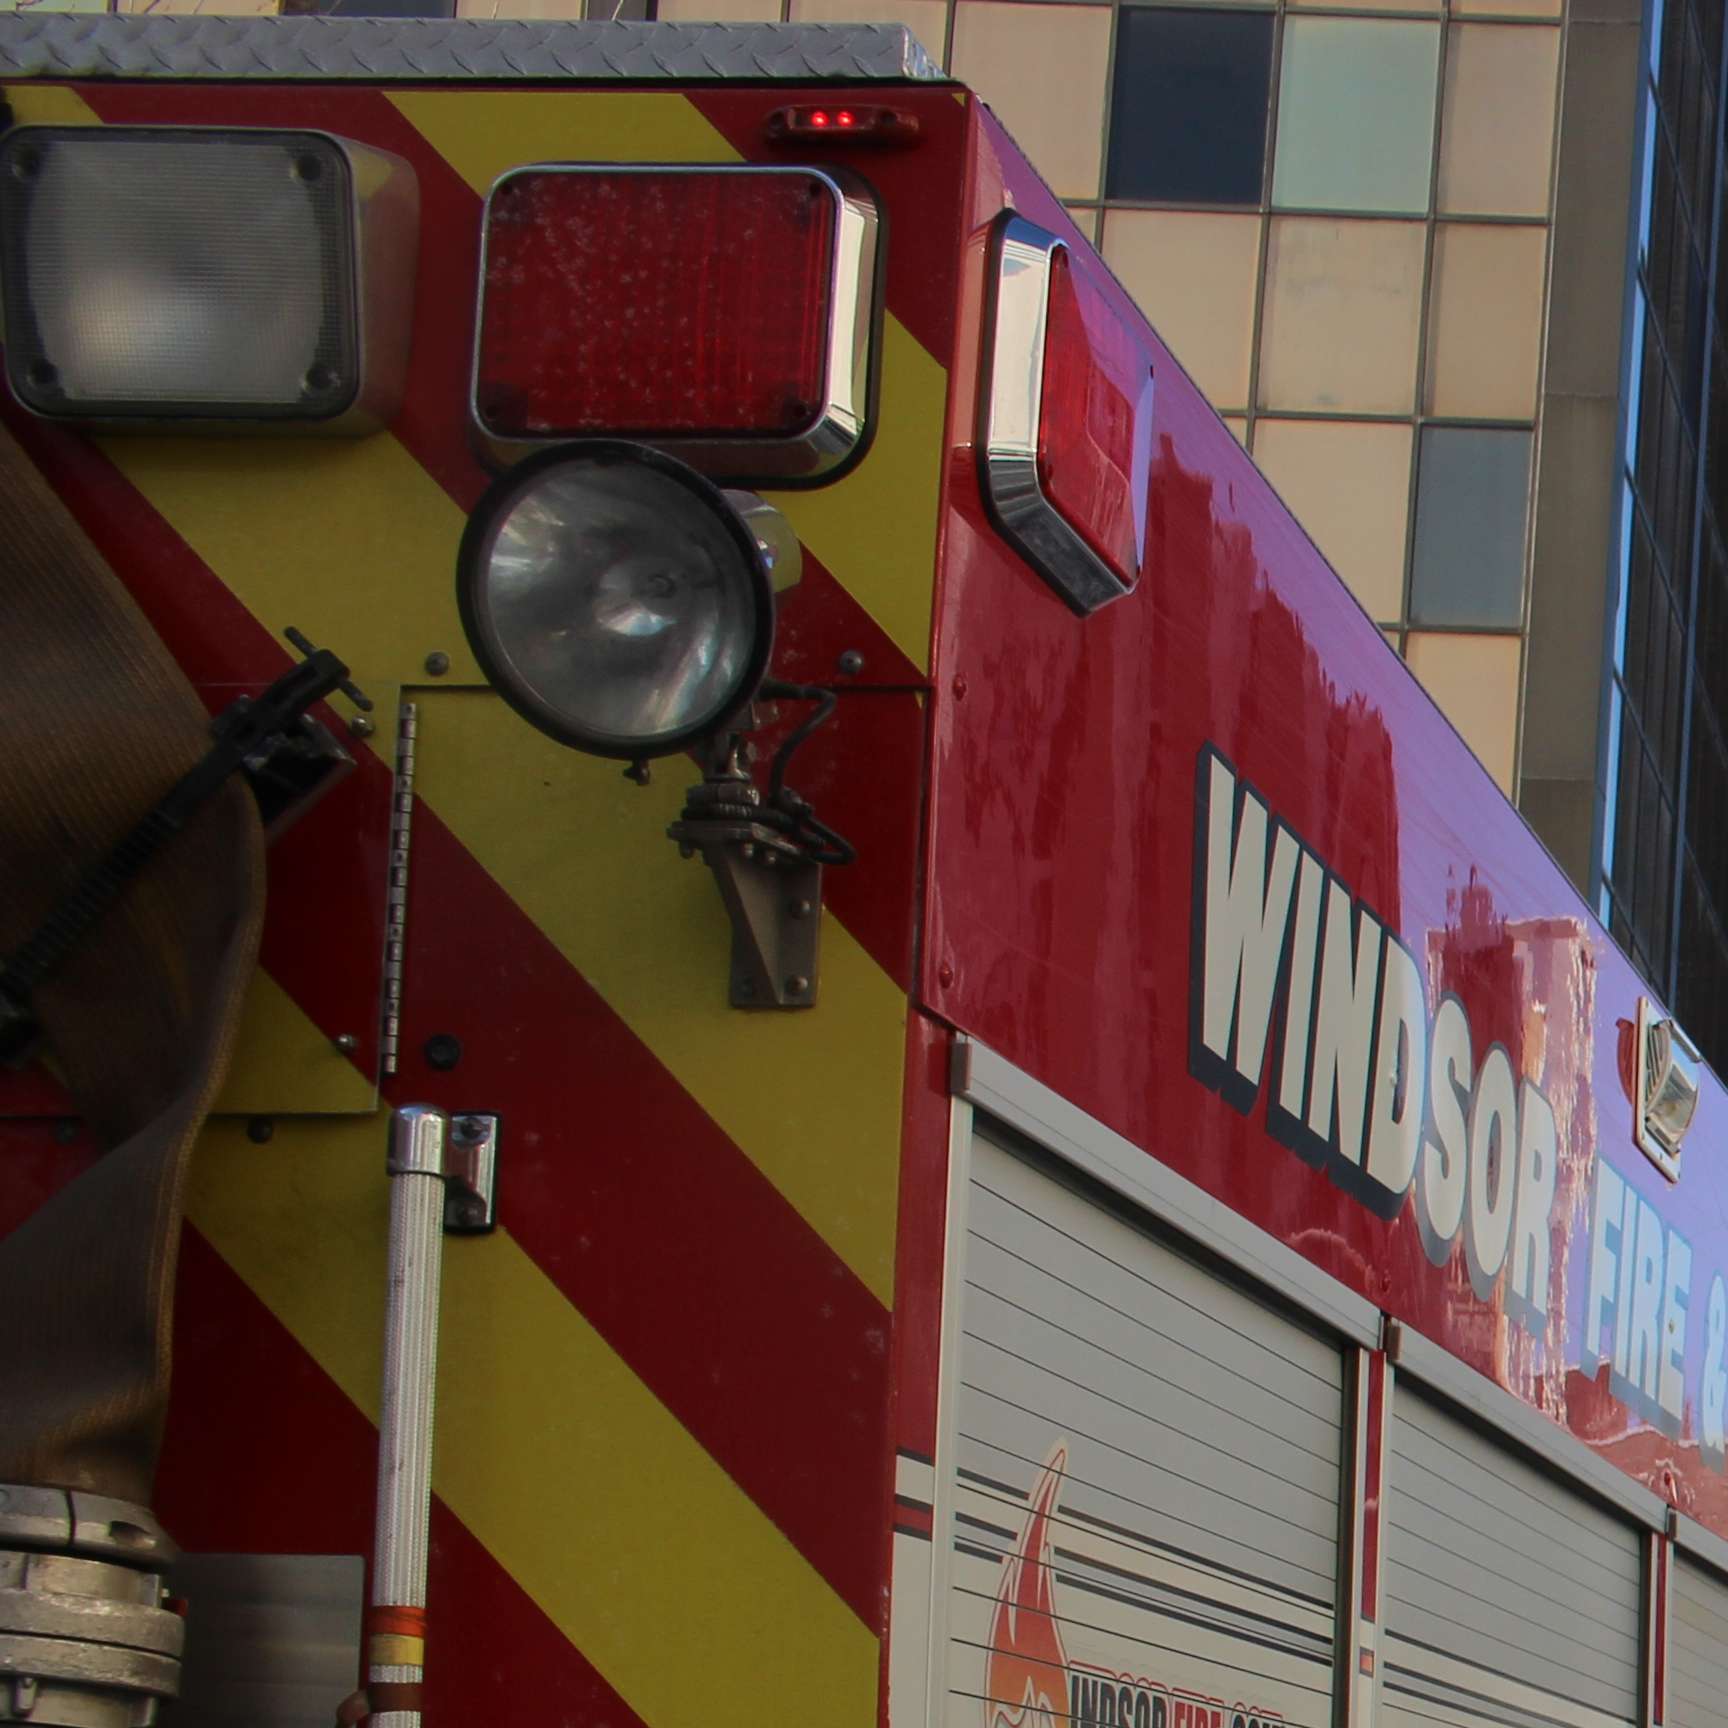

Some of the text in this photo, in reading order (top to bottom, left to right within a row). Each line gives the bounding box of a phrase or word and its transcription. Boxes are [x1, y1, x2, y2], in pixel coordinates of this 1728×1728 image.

[1190, 742, 1558, 1325] WINDSOR
[1582, 1158, 1691, 1437] FIRE
[1699, 1271, 1728, 1472] &
